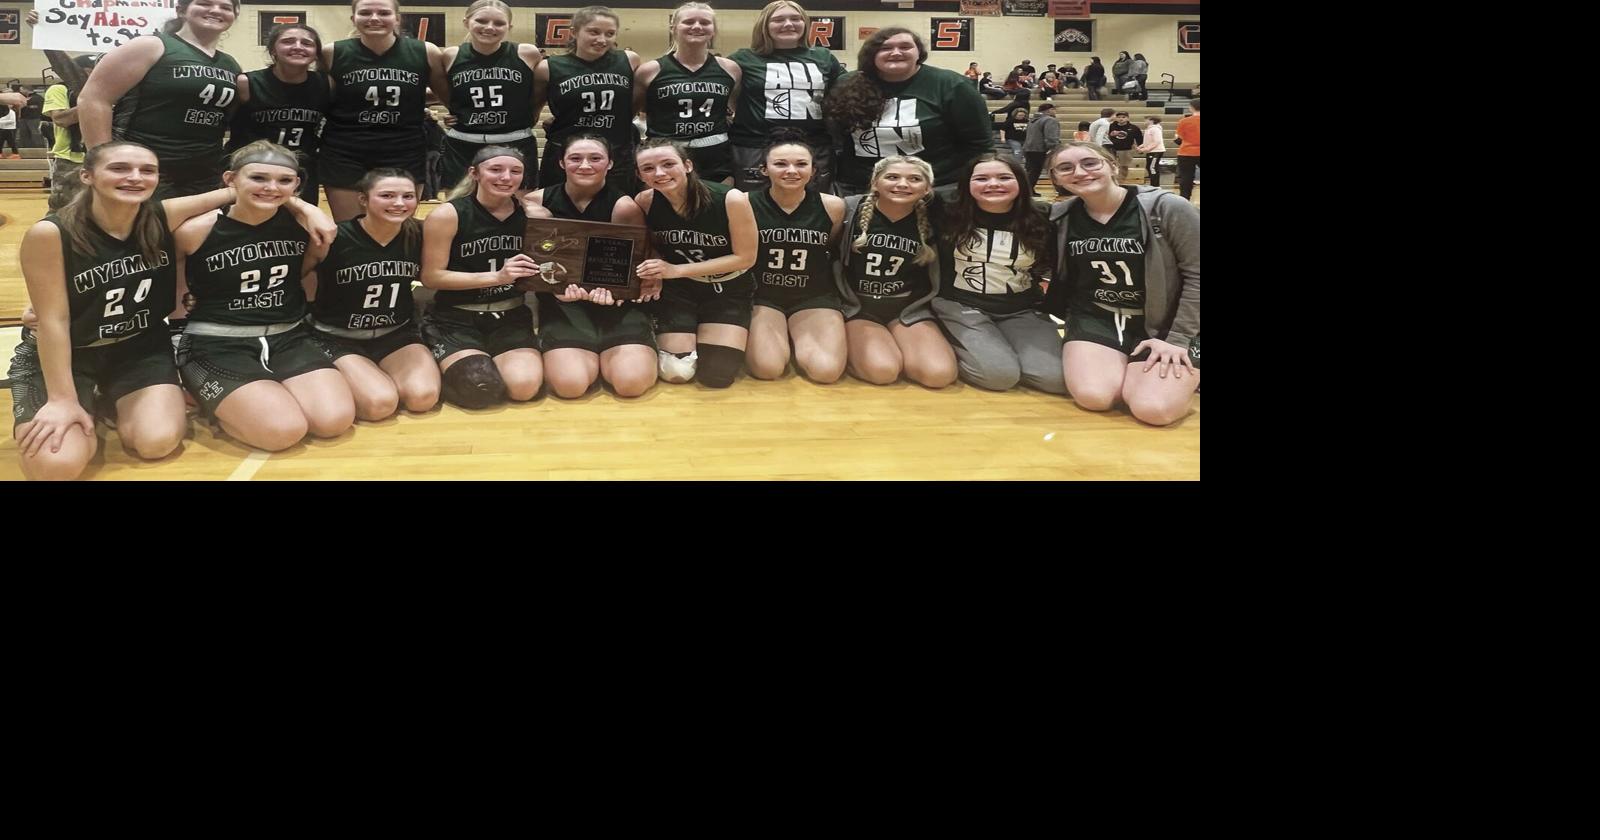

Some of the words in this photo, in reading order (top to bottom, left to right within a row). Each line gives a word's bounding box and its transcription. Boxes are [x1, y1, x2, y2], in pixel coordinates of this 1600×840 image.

[45, 8, 91, 30] Say
[86, 28, 113, 46] to
[545, 18, 572, 45] G
[808, 21, 834, 47] R
[936, 22, 962, 48] S
[342, 67, 420, 86] WYOMING
[452, 66, 523, 87] WYOMING
[764, 62, 825, 89] ALL
[199, 83, 235, 108] 40
[364, 85, 401, 107] 43
[469, 85, 504, 108] 25
[581, 89, 615, 113] 30
[184, 108, 224, 126] EAST
[358, 110, 400, 125] EAST
[468, 110, 508, 125] EAST
[677, 98, 714, 118] 34
[872, 97, 919, 127] LL
[277, 127, 304, 147] 13
[675, 121, 715, 135] EAST
[768, 248, 808, 271] 33
[865, 252, 905, 277] 23
[240, 264, 289, 293] 22
[762, 271, 809, 288] EAST
[1090, 260, 1134, 287] 31
[362, 282, 400, 309] 21
[859, 279, 904, 296] EAST
[228, 290, 285, 311] EAST
